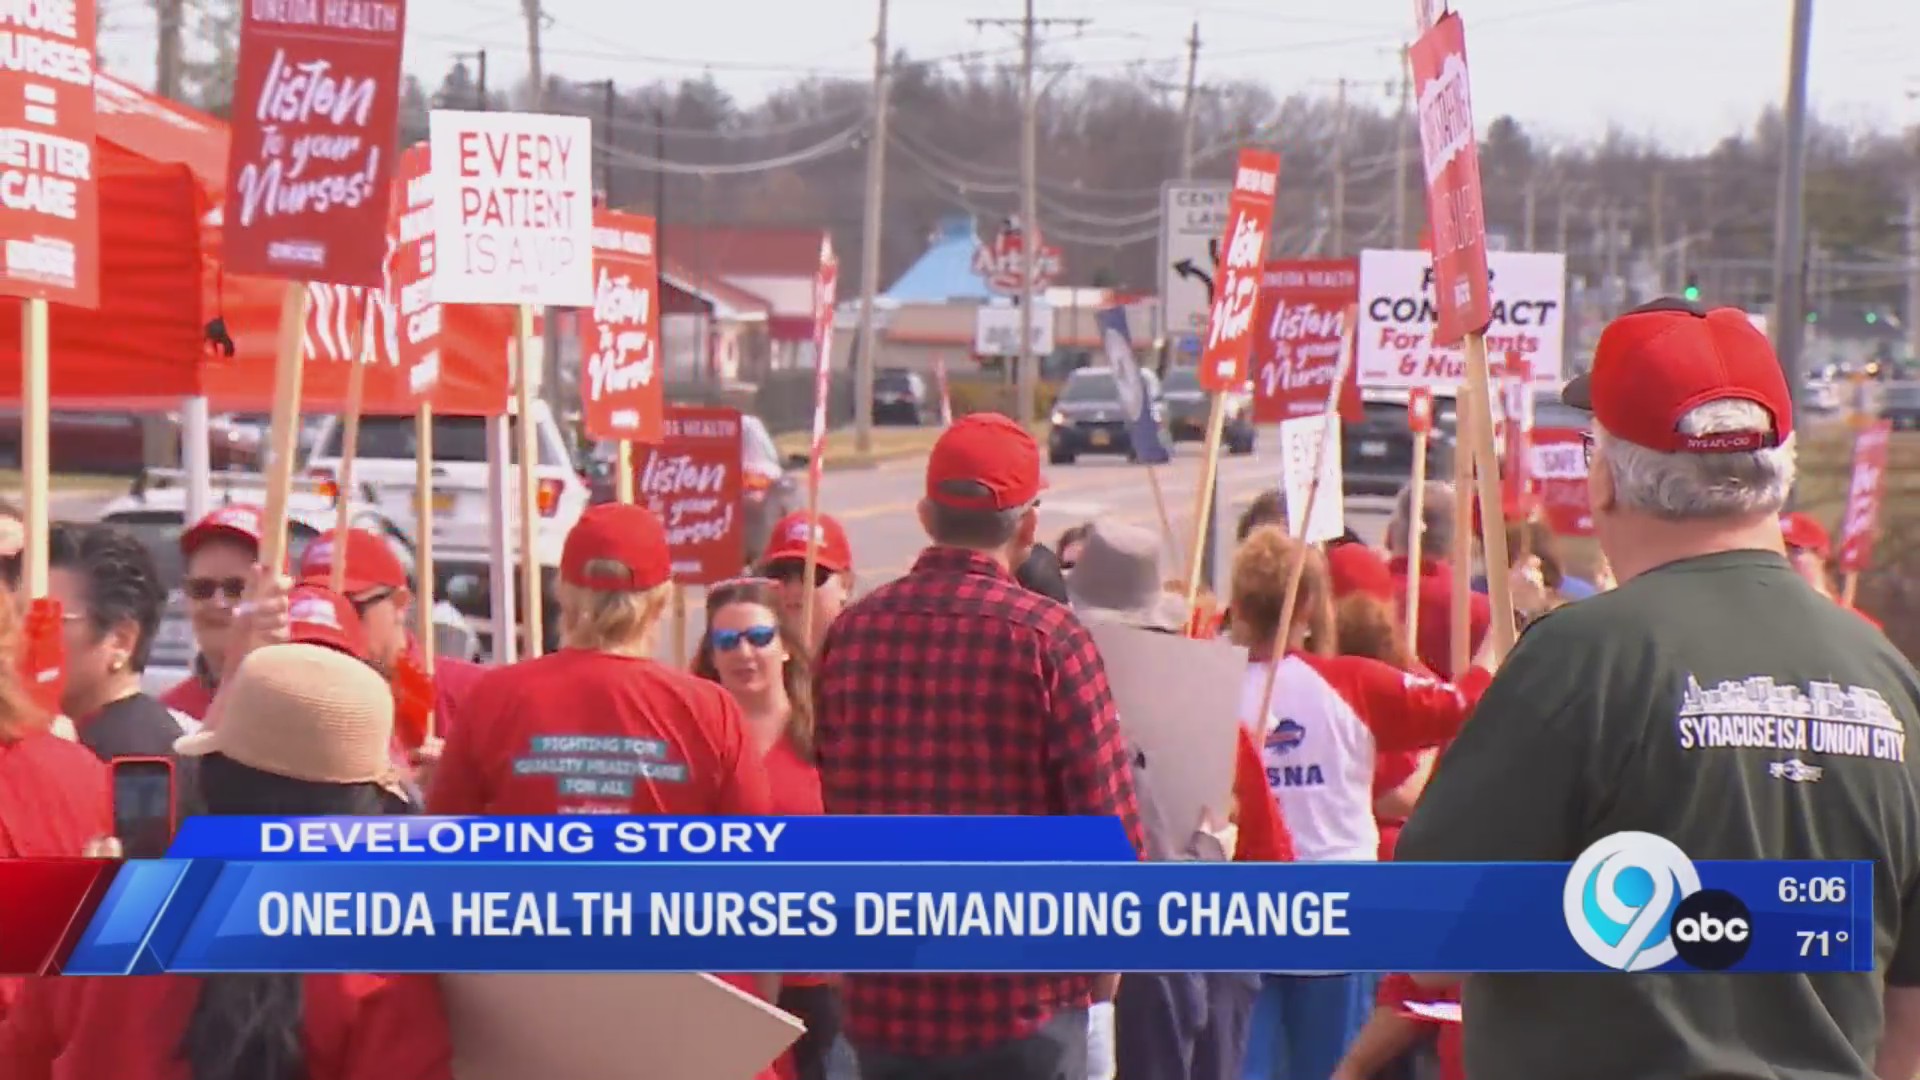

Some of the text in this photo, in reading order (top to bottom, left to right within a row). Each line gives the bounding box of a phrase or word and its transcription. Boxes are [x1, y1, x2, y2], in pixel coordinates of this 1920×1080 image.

[287, 135, 361, 179] your
[459, 131, 573, 181] EVERY
[0, 170, 77, 219] CARE
[237, 145, 380, 226] Nurses!
[461, 186, 576, 229] PATIENT
[464, 233, 498, 275] IS
[507, 236, 527, 275] A
[1369, 297, 1556, 327] CONACT
[1380, 328, 1425, 351] For
[541, 736, 659, 755] FIGHTING FOR
[1680, 716, 1775, 750] SYRACUSE
[1812, 725, 1869, 757] UNION
[1873, 730, 1906, 763] CITY
[514, 758, 582, 774] QUALITY
[566, 778, 625, 795] FOR ALL
